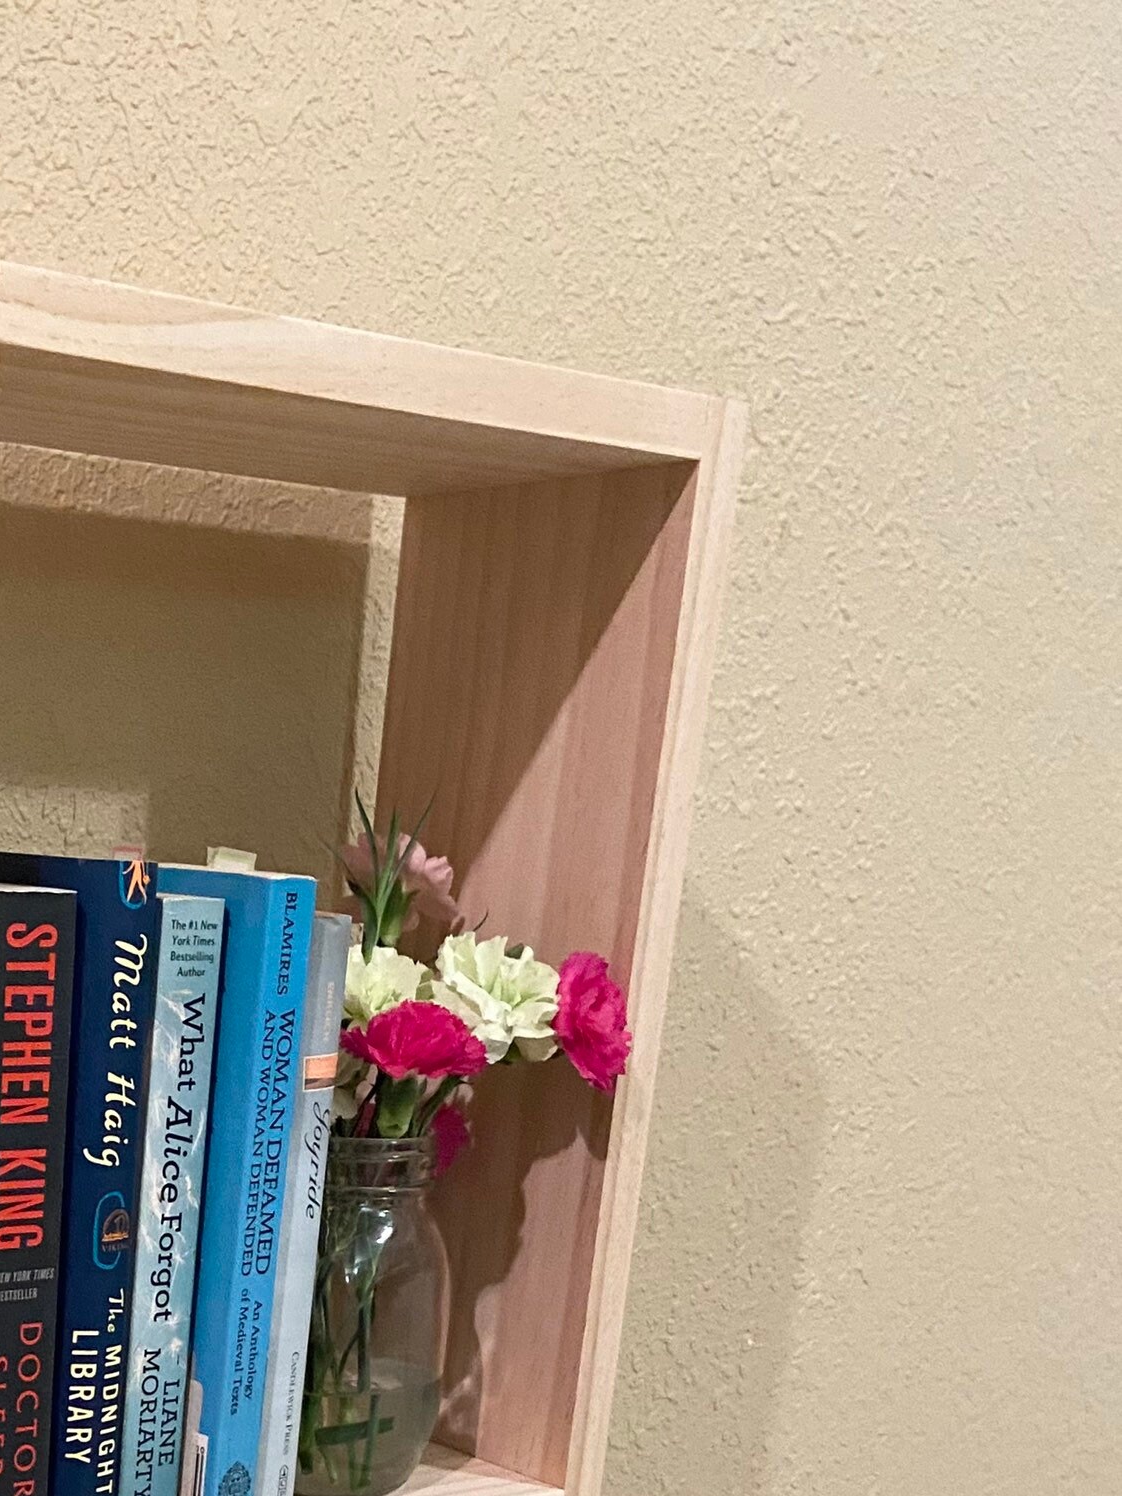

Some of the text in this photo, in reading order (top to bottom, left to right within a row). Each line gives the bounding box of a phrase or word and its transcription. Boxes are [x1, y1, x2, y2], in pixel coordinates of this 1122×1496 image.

[170, 950, 214, 964] Bestselling
[171, 919, 218, 931] The #1 New
[172, 935, 215, 946] York Times
[177, 966, 206, 977] Author
[276, 891, 298, 996] BLAMIRES
[0, 922, 59, 1126] STEPHEN
[82, 933, 148, 1168] Matt Haig
[150, 993, 206, 1323] What Alice Forgot
[241, 1010, 277, 1277] AND WOMAN DEFENDED
[255, 1008, 296, 1275] WOMAN DEFAMED
[304, 1102, 331, 1220] Joyride
[12, 1270, 31, 1282] YORK
[33, 1267, 55, 1280] TIMES
[64, 1330, 100, 1464] LIBRARY
[95, 1288, 124, 1494] The MIDNIGHT
[230, 1288, 251, 1416] of Medieval Texts
[244, 1300, 263, 1400] An Anthology
[158, 1379, 182, 1468] LIANE
